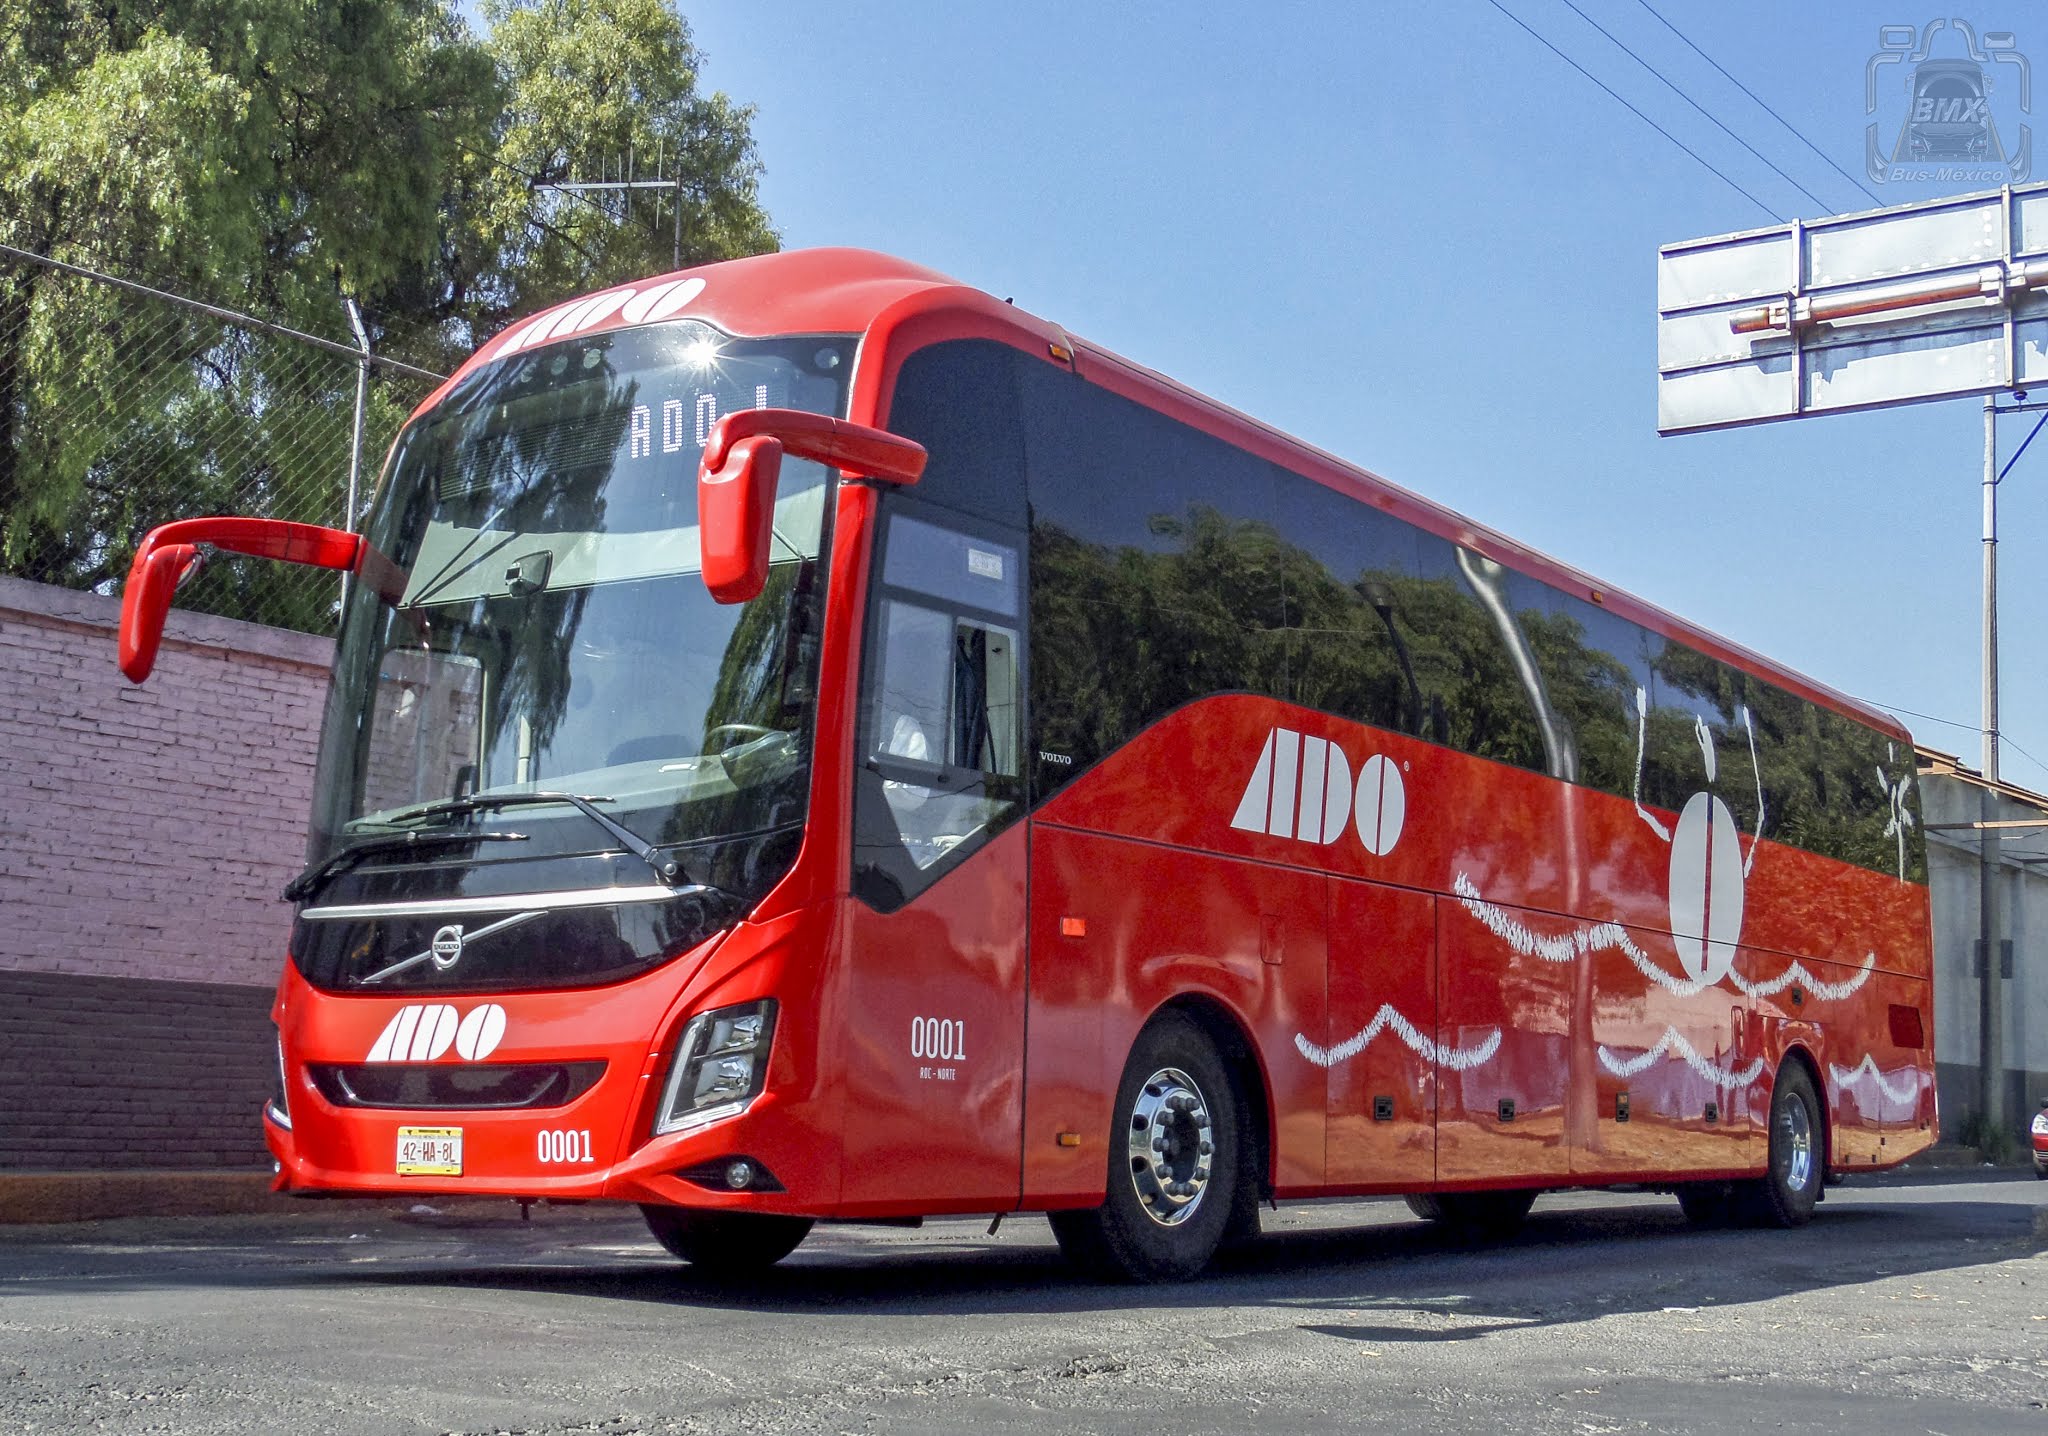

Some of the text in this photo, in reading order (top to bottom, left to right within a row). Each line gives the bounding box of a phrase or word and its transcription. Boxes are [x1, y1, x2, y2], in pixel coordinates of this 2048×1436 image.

[490, 278, 707, 361] ADO
[1039, 751, 1072, 765] VOLVO
[1230, 727, 1406, 856] ADO
[434, 943, 460, 951] VOLVO
[365, 1003, 507, 1062] ADO
[911, 1016, 966, 1060] 0001
[537, 1129, 594, 1163] 0001
